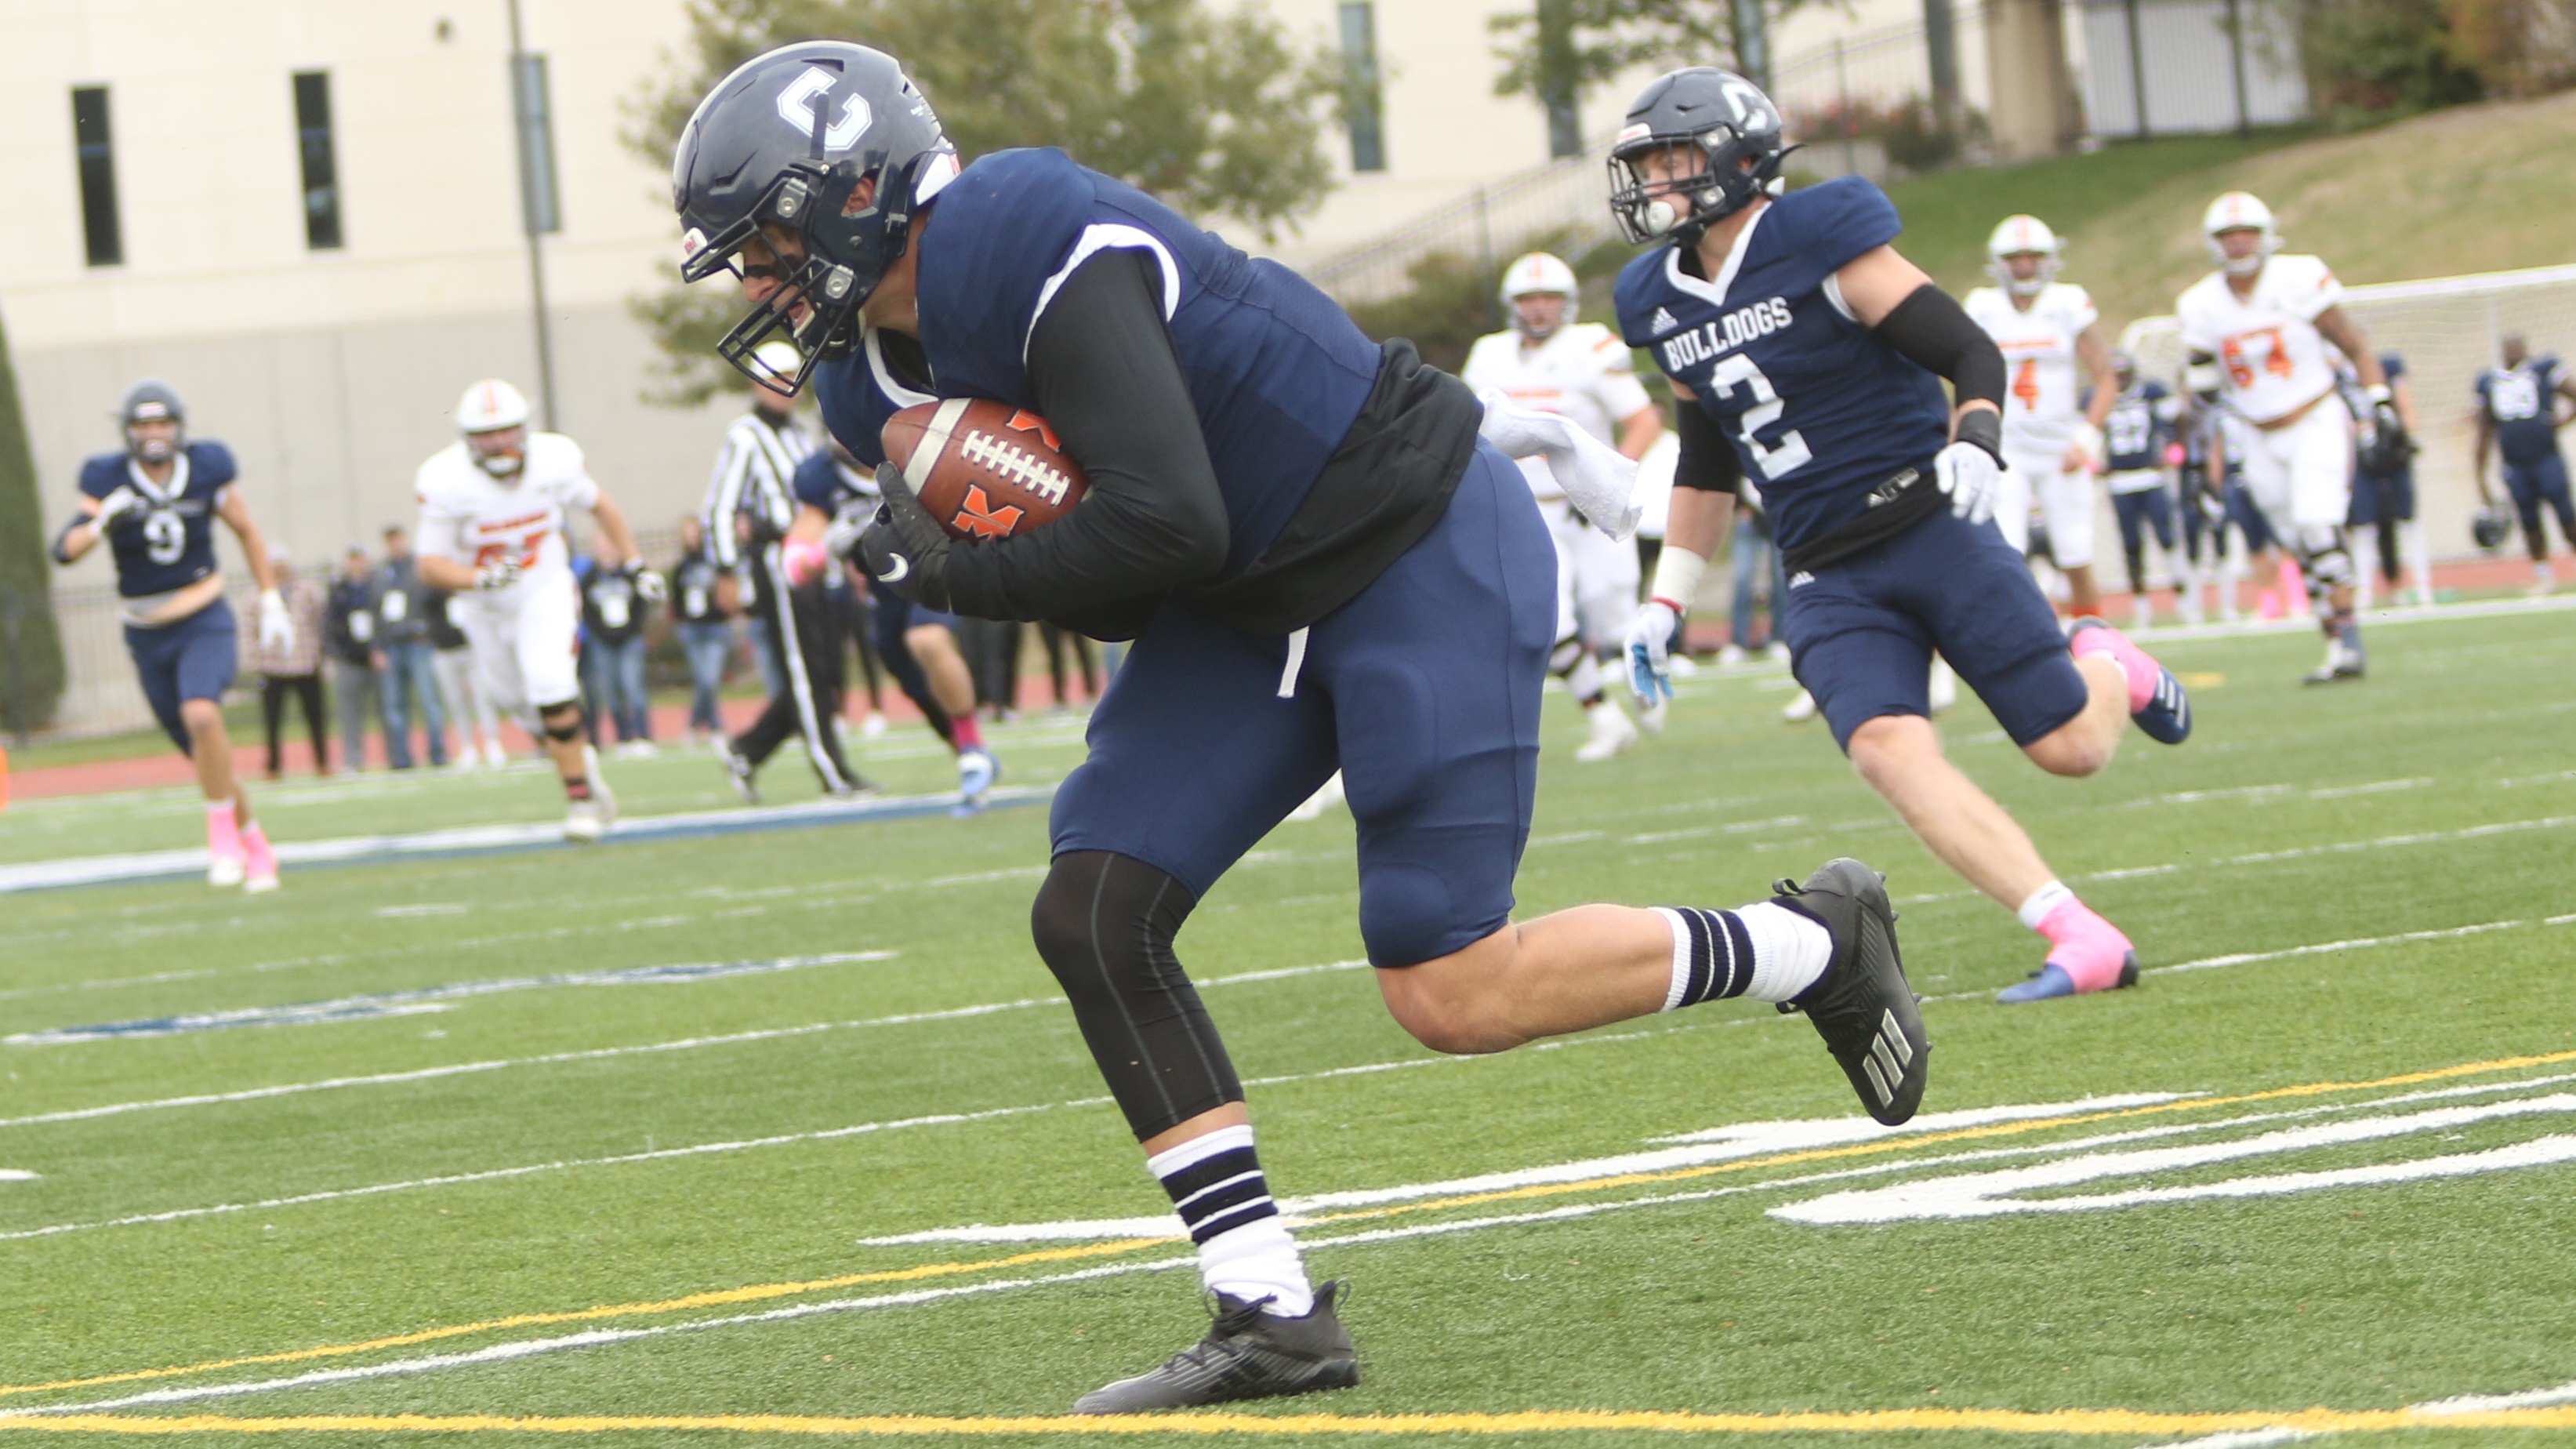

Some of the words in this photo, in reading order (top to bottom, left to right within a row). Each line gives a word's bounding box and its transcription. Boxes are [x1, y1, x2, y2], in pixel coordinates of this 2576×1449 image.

[777, 67, 873, 151] C
[1662, 296, 1793, 373] BULLDOGS
[1710, 353, 1813, 481] 2
[2013, 358, 2039, 411] 4
[143, 509, 186, 565] 9
